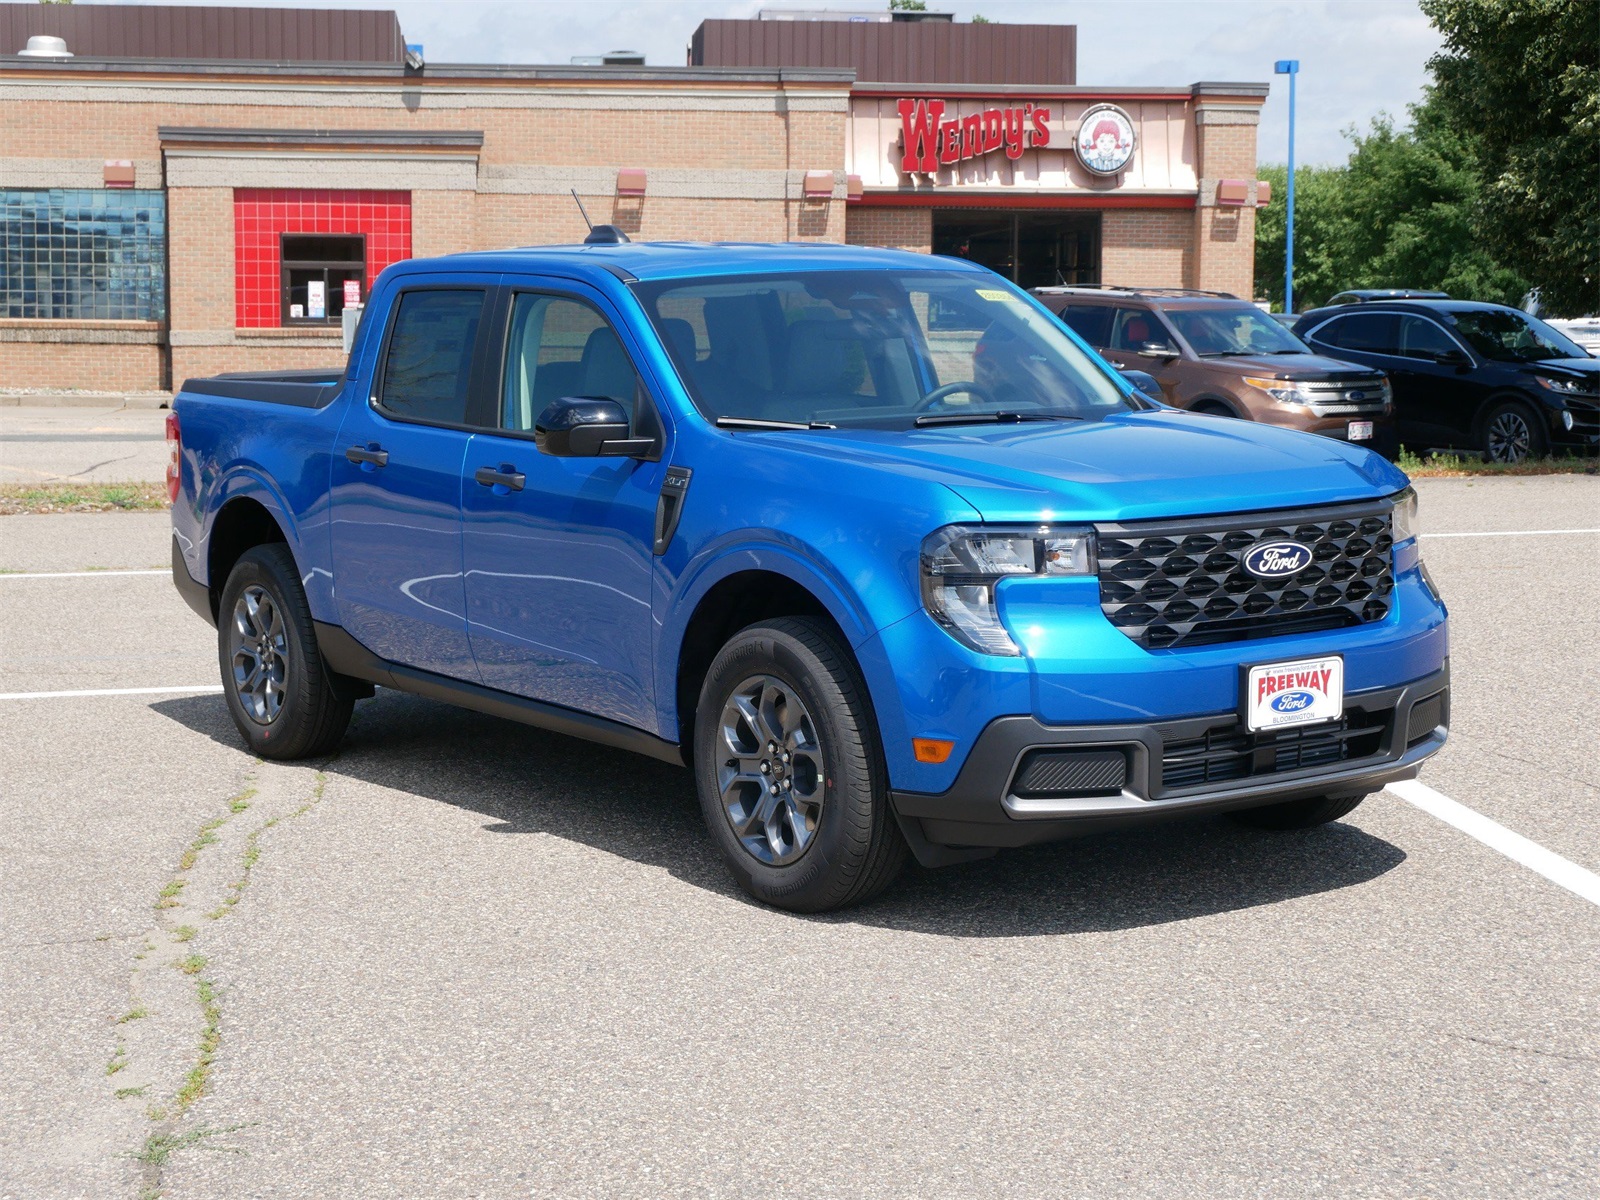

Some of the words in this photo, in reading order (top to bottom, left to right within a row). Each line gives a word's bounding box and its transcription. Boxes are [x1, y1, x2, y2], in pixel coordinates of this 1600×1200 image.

[664, 476, 686, 486] XLT
[1259, 548, 1301, 572] Ford
[1258, 669, 1332, 708] FREEWAY
[1278, 693, 1308, 711] Ford
[1272, 712, 1315, 724] BLOOMINGTON
